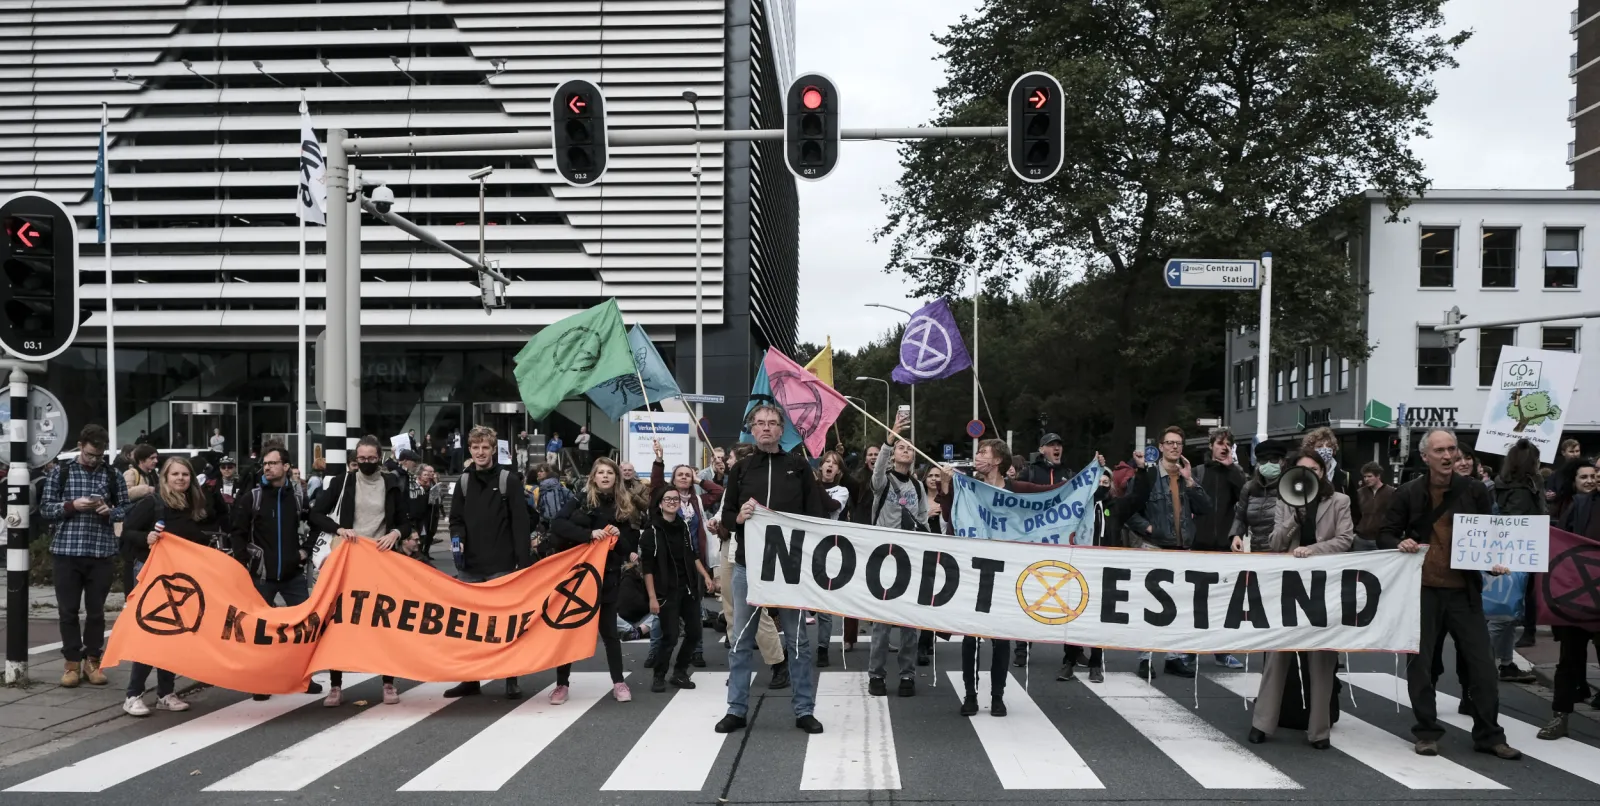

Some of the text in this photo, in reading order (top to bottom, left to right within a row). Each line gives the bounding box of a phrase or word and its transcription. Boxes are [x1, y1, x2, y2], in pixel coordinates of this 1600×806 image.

[1206, 264, 1242, 272] Centraal
[1222, 275, 1253, 283] Station
[24, 341, 42, 350] 03.1
[1397, 407, 1458, 421] MUNT
[638, 424, 674, 432] Verkershinder
[992, 492, 1062, 511] HOUDEN
[1070, 466, 1098, 491] HET
[978, 501, 1085, 533] NIET DROOG
[1459, 515, 1529, 526] THE HAGUE
[1457, 538, 1536, 551] CLIMATE
[1456, 550, 1539, 565] JUSTICE
[761, 524, 1382, 629] NOODT ESTAND
[221, 590, 536, 645] KLIMATREBELLIE
